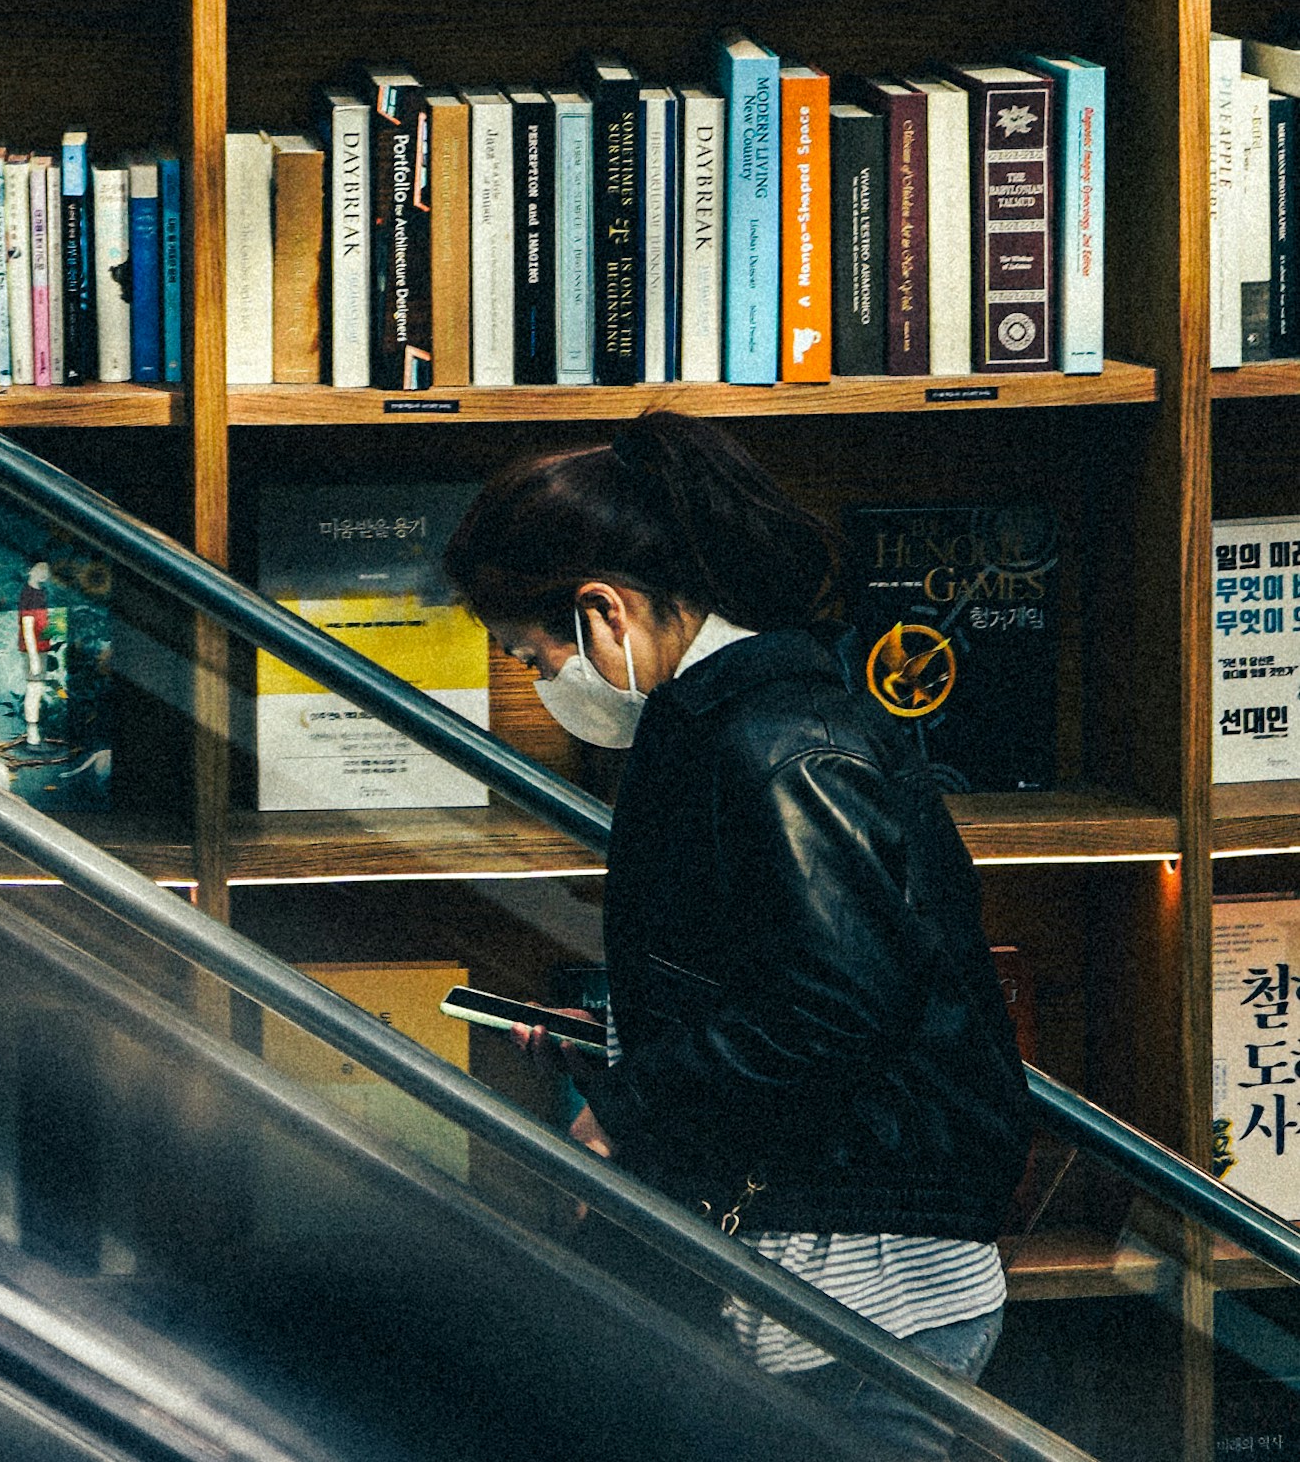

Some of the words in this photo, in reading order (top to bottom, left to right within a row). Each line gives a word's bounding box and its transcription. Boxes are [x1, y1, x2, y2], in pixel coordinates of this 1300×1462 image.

[741, 94, 755, 124] New
[755, 77, 768, 144] MODERN
[799, 105, 810, 149] Space
[741, 126, 755, 180] Country
[755, 149, 768, 199] LIVING
[343, 132, 360, 255] DAYBREAK
[799, 157, 810, 283] Mango-Shaped
[799, 294, 810, 307] A
